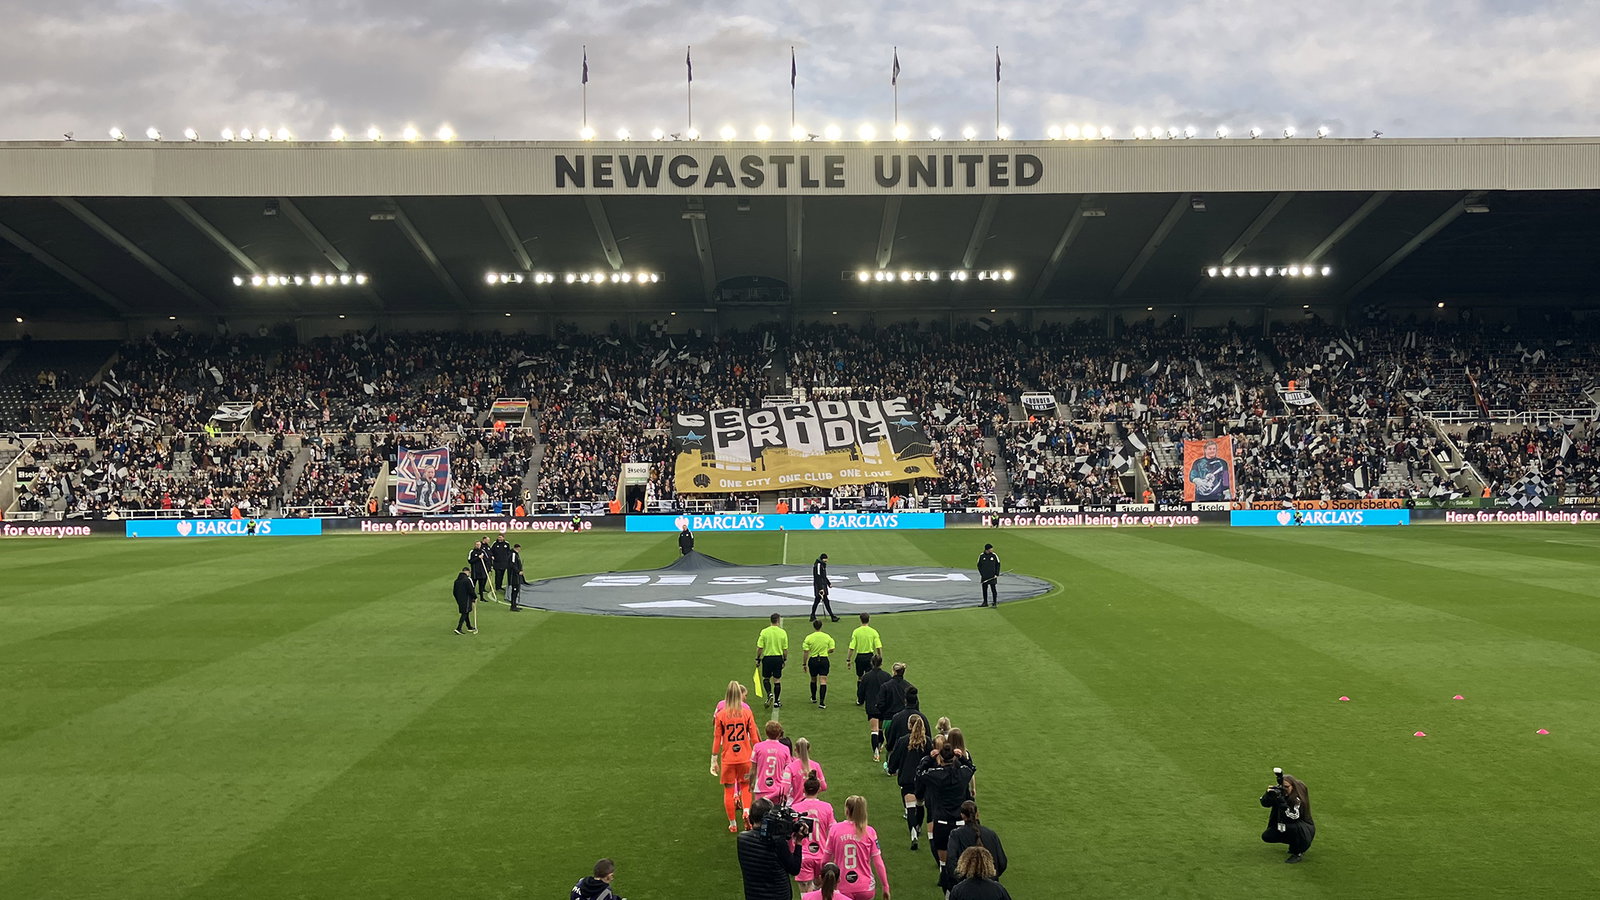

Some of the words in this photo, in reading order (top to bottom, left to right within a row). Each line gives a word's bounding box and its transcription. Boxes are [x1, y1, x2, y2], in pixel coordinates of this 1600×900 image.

[555, 154, 845, 188] NEWCASTLE
[874, 154, 1043, 187] UNITED
[717, 420, 887, 448] PRIDE
[720, 478, 742, 488] ONE
[746, 478, 771, 486] CITY
[778, 474, 802, 484] ONE
[804, 472, 833, 482] CLUB
[840, 468, 862, 478] ONE
[693, 516, 765, 530] BARCLAYS
[828, 515, 898, 528] BARCLAYS
[982, 515, 1012, 526] Hre
[1014, 515, 1032, 526] for
[1034, 514, 1082, 525] football
[1085, 514, 1119, 527] being
[1121, 514, 1139, 524] for
[1142, 514, 1199, 527] everyone
[1299, 511, 1363, 524] ARCLAYS
[1445, 511, 1475, 522] Here
[1476, 511, 1494, 522] for
[1496, 510, 1543, 522] football
[1545, 510, 1578, 524] being
[1580, 510, 1598, 521] for
[4, 524, 24, 536] for
[27, 525, 91, 538] everyone
[361, 520, 393, 532] Here
[395, 520, 415, 531] for
[418, 519, 468, 531] football
[471, 520, 507, 532] being
[510, 519, 529, 530] for
[726, 723, 744, 742] 22
[766, 756, 777, 776] 3
[844, 844, 857, 869] 8
